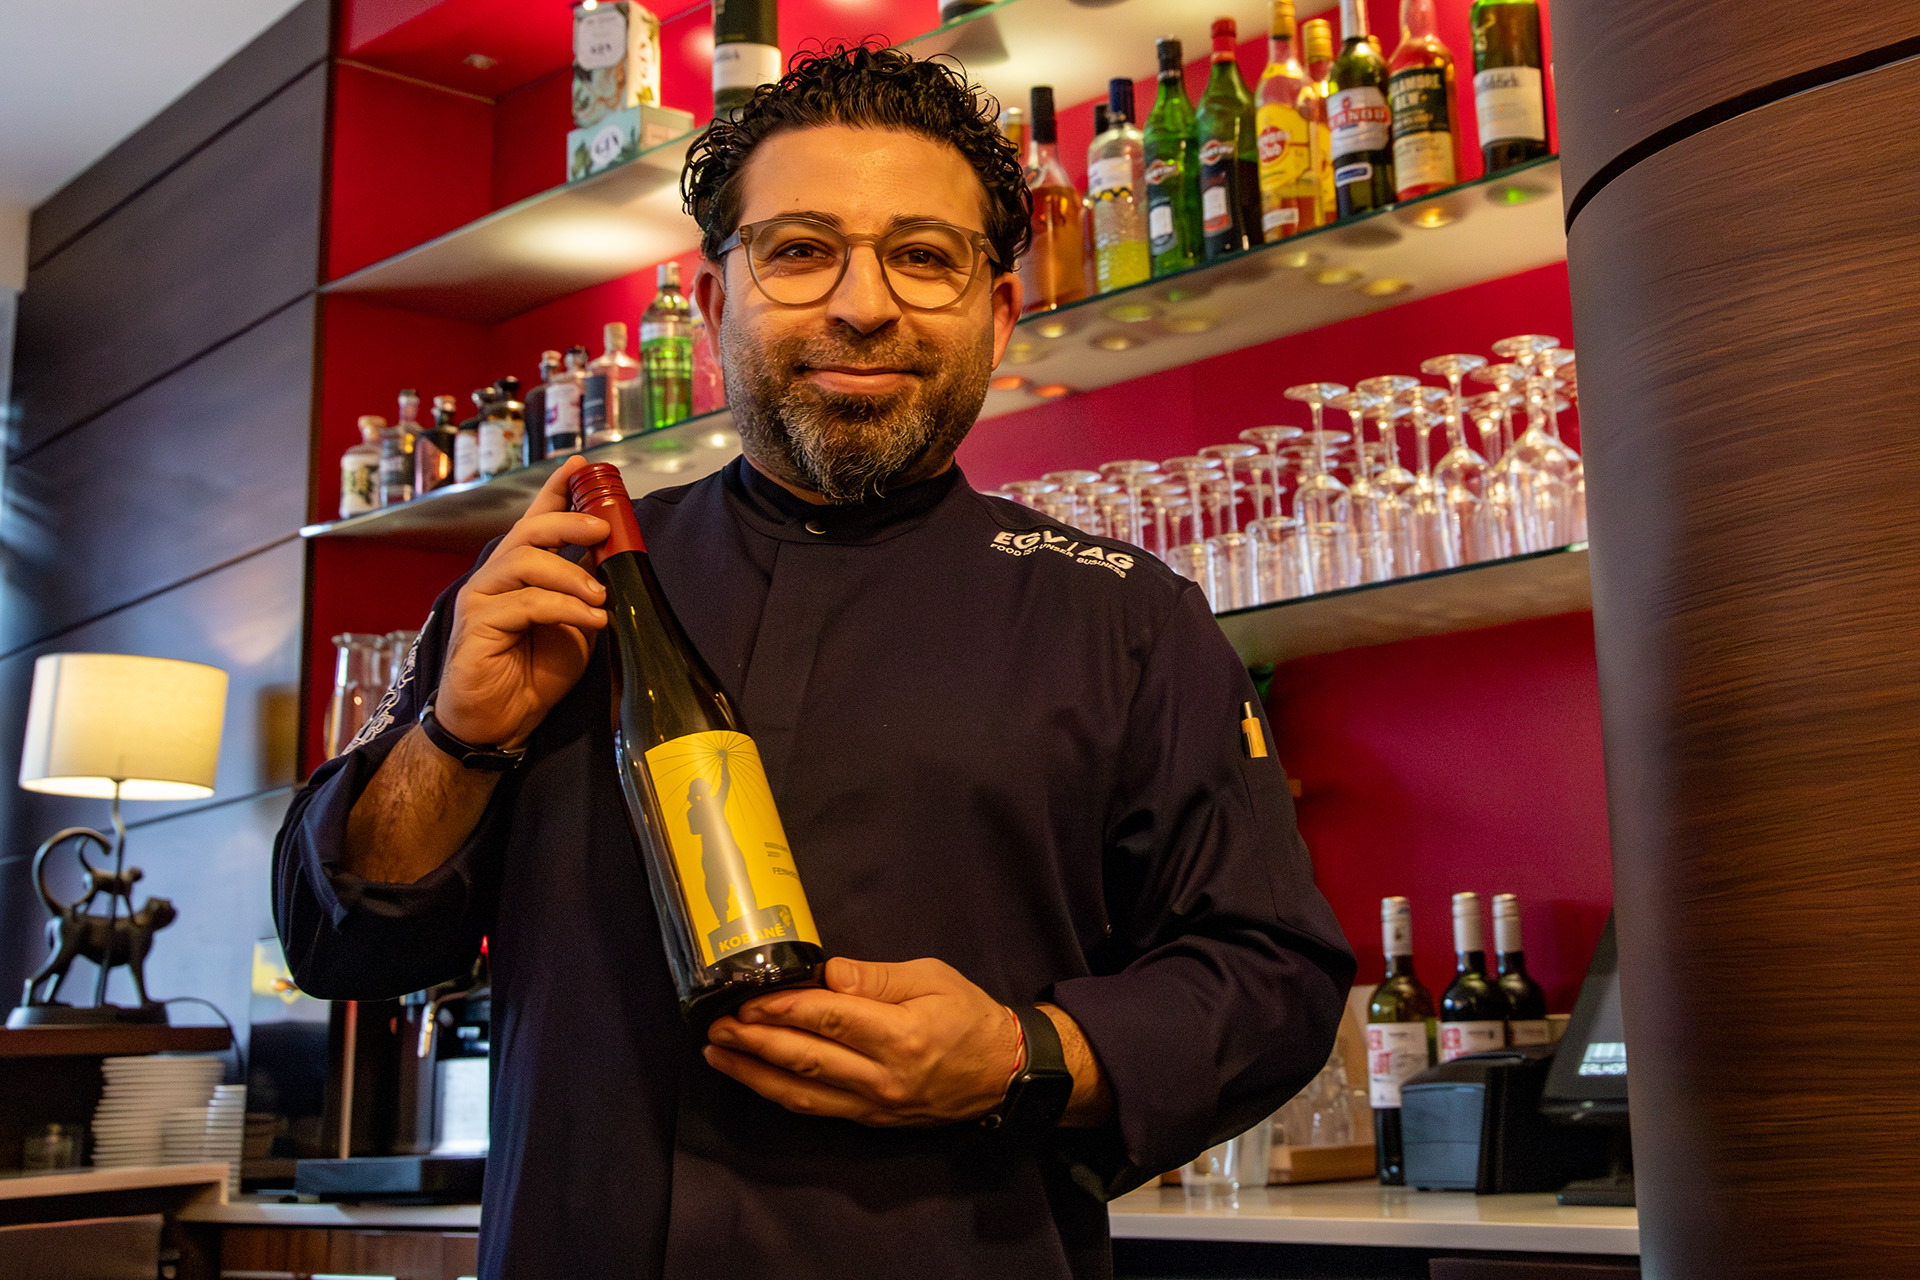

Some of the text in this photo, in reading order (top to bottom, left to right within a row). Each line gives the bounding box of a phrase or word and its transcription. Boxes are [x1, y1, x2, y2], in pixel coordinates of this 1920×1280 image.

[990, 543, 1022, 557] FOOD
[1039, 543, 1075, 558] UNSER
[1076, 557, 1127, 579] BUSINESS
[1077, 546, 1135, 570] AG
[718, 923, 786, 953] KOBANÉ
